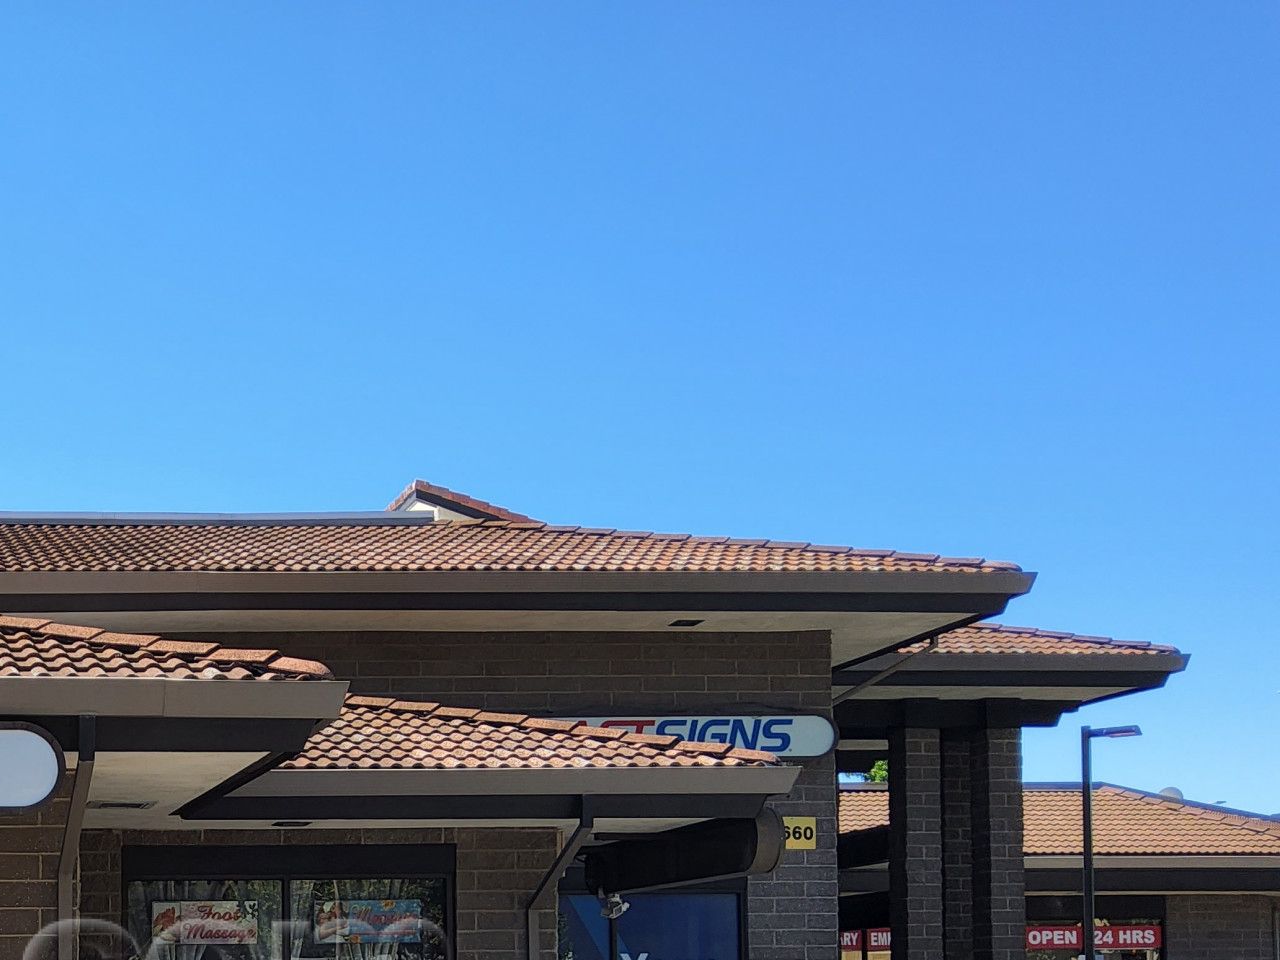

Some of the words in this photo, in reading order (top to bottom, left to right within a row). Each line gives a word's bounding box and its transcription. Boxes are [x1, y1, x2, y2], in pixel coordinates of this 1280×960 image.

[1028, 930, 1078, 945] OPEN
[1093, 930, 1114, 945] 24
[1118, 929, 1155, 944] HRS
